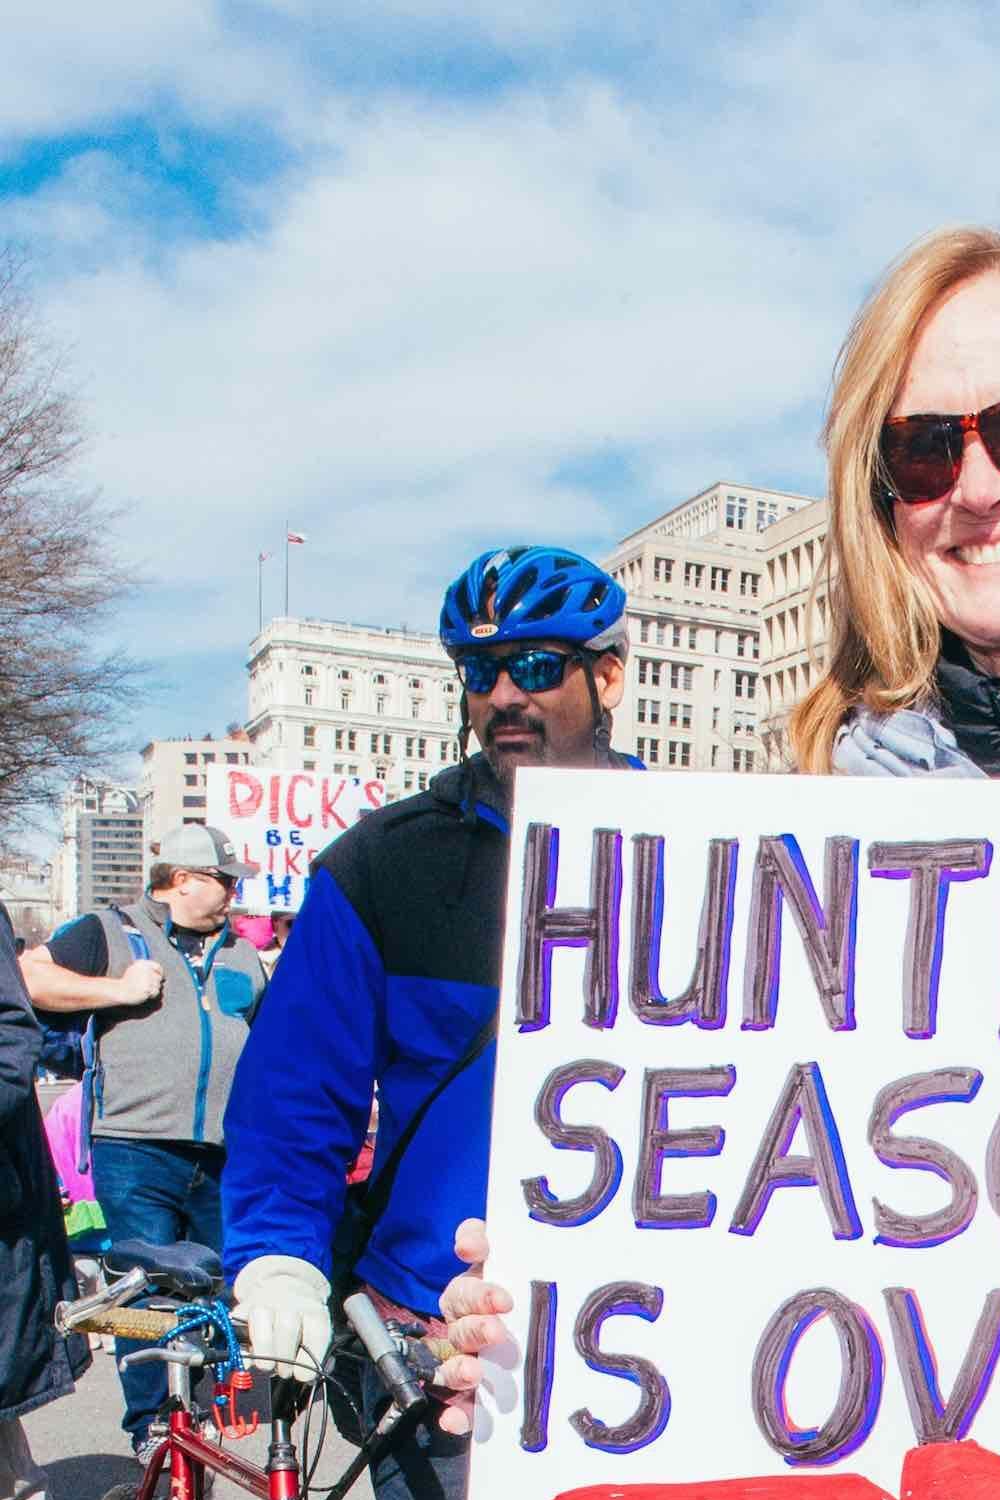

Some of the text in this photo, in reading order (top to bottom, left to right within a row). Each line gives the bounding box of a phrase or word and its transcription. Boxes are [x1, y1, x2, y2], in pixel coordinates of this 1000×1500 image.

[228, 770, 384, 829] DICK'S
[266, 829, 304, 846] BE
[519, 1280, 672, 1456] IS
